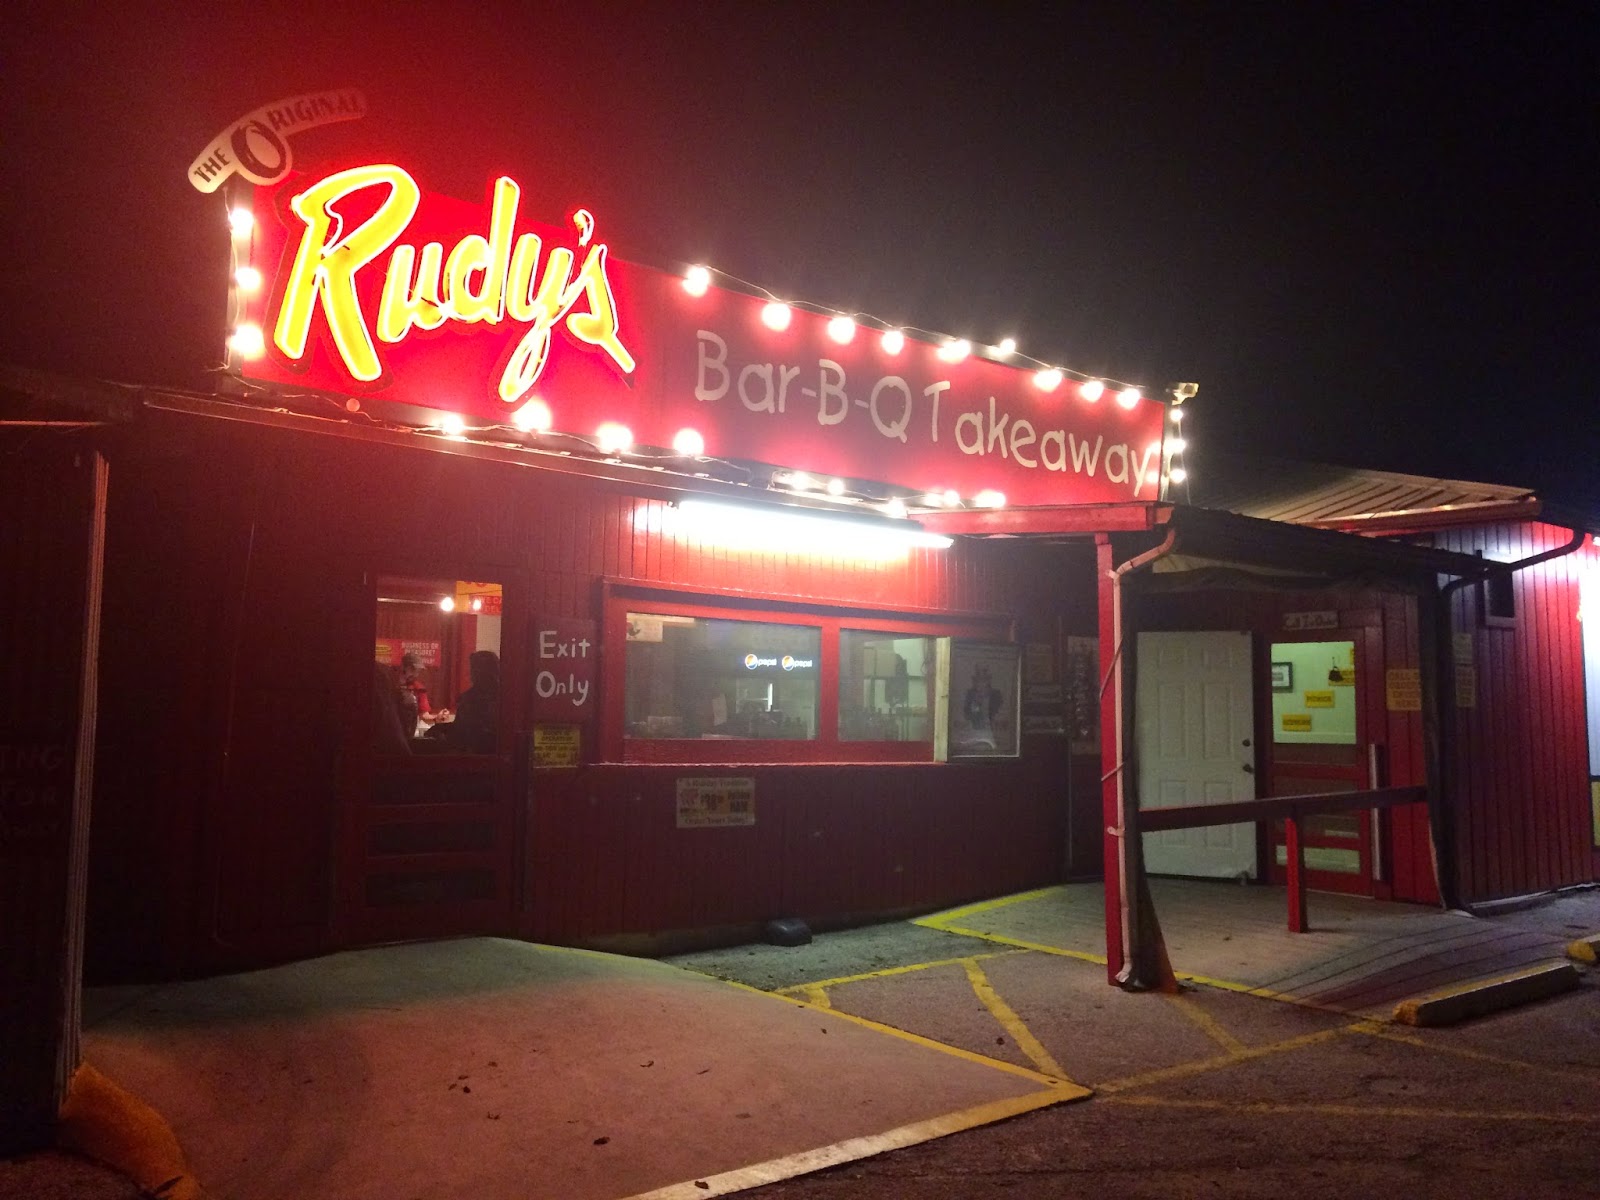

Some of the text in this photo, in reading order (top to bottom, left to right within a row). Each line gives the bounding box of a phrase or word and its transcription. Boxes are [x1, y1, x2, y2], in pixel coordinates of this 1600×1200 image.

[193, 93, 363, 183] THE ORIGINAL
[273, 164, 636, 402] Rudy's
[694, 329, 911, 443] Bar-B-Q
[535, 670, 590, 707] Only
[539, 630, 591, 659] Exit
